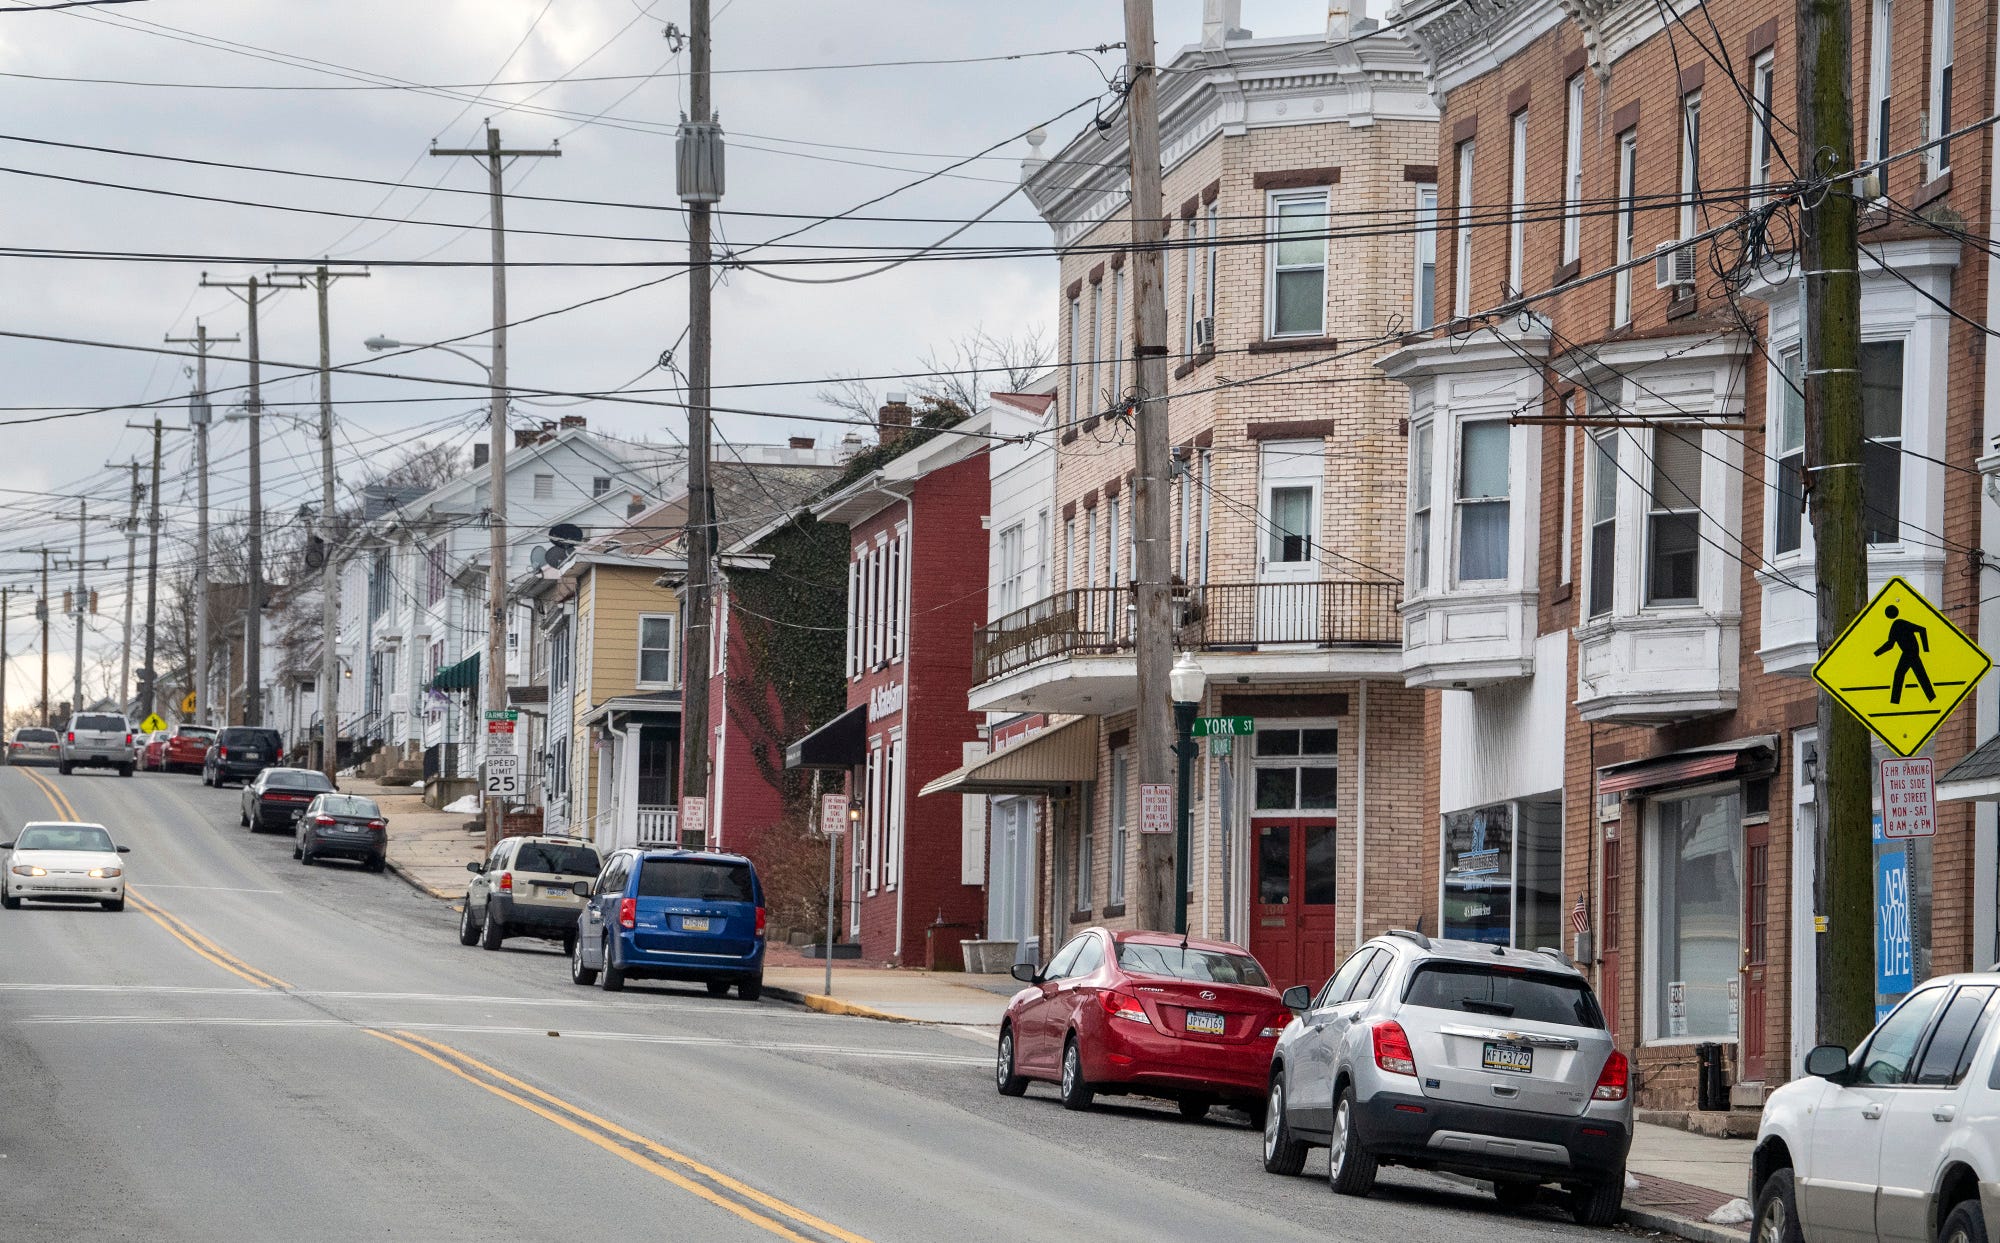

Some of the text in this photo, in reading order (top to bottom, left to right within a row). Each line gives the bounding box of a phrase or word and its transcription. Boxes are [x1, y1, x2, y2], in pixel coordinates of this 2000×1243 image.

[1204, 718, 1234, 734] YORK
[1244, 720, 1252, 732] ST
[1885, 765, 1929, 776] 2 HR PARKING
[488, 776, 515, 792] 25
[1890, 779, 1926, 790] THIS SIDE
[1890, 792, 1926, 803] OF STREET
[1892, 807, 1906, 817] MON
[1915, 806, 1927, 816] SAT
[1890, 821, 1893, 831] 8
[1897, 820, 1906, 830] AM
[1914, 820, 1918, 829] 6
[1922, 820, 1930, 829] PM
[1884, 938, 1910, 976] LIFE
